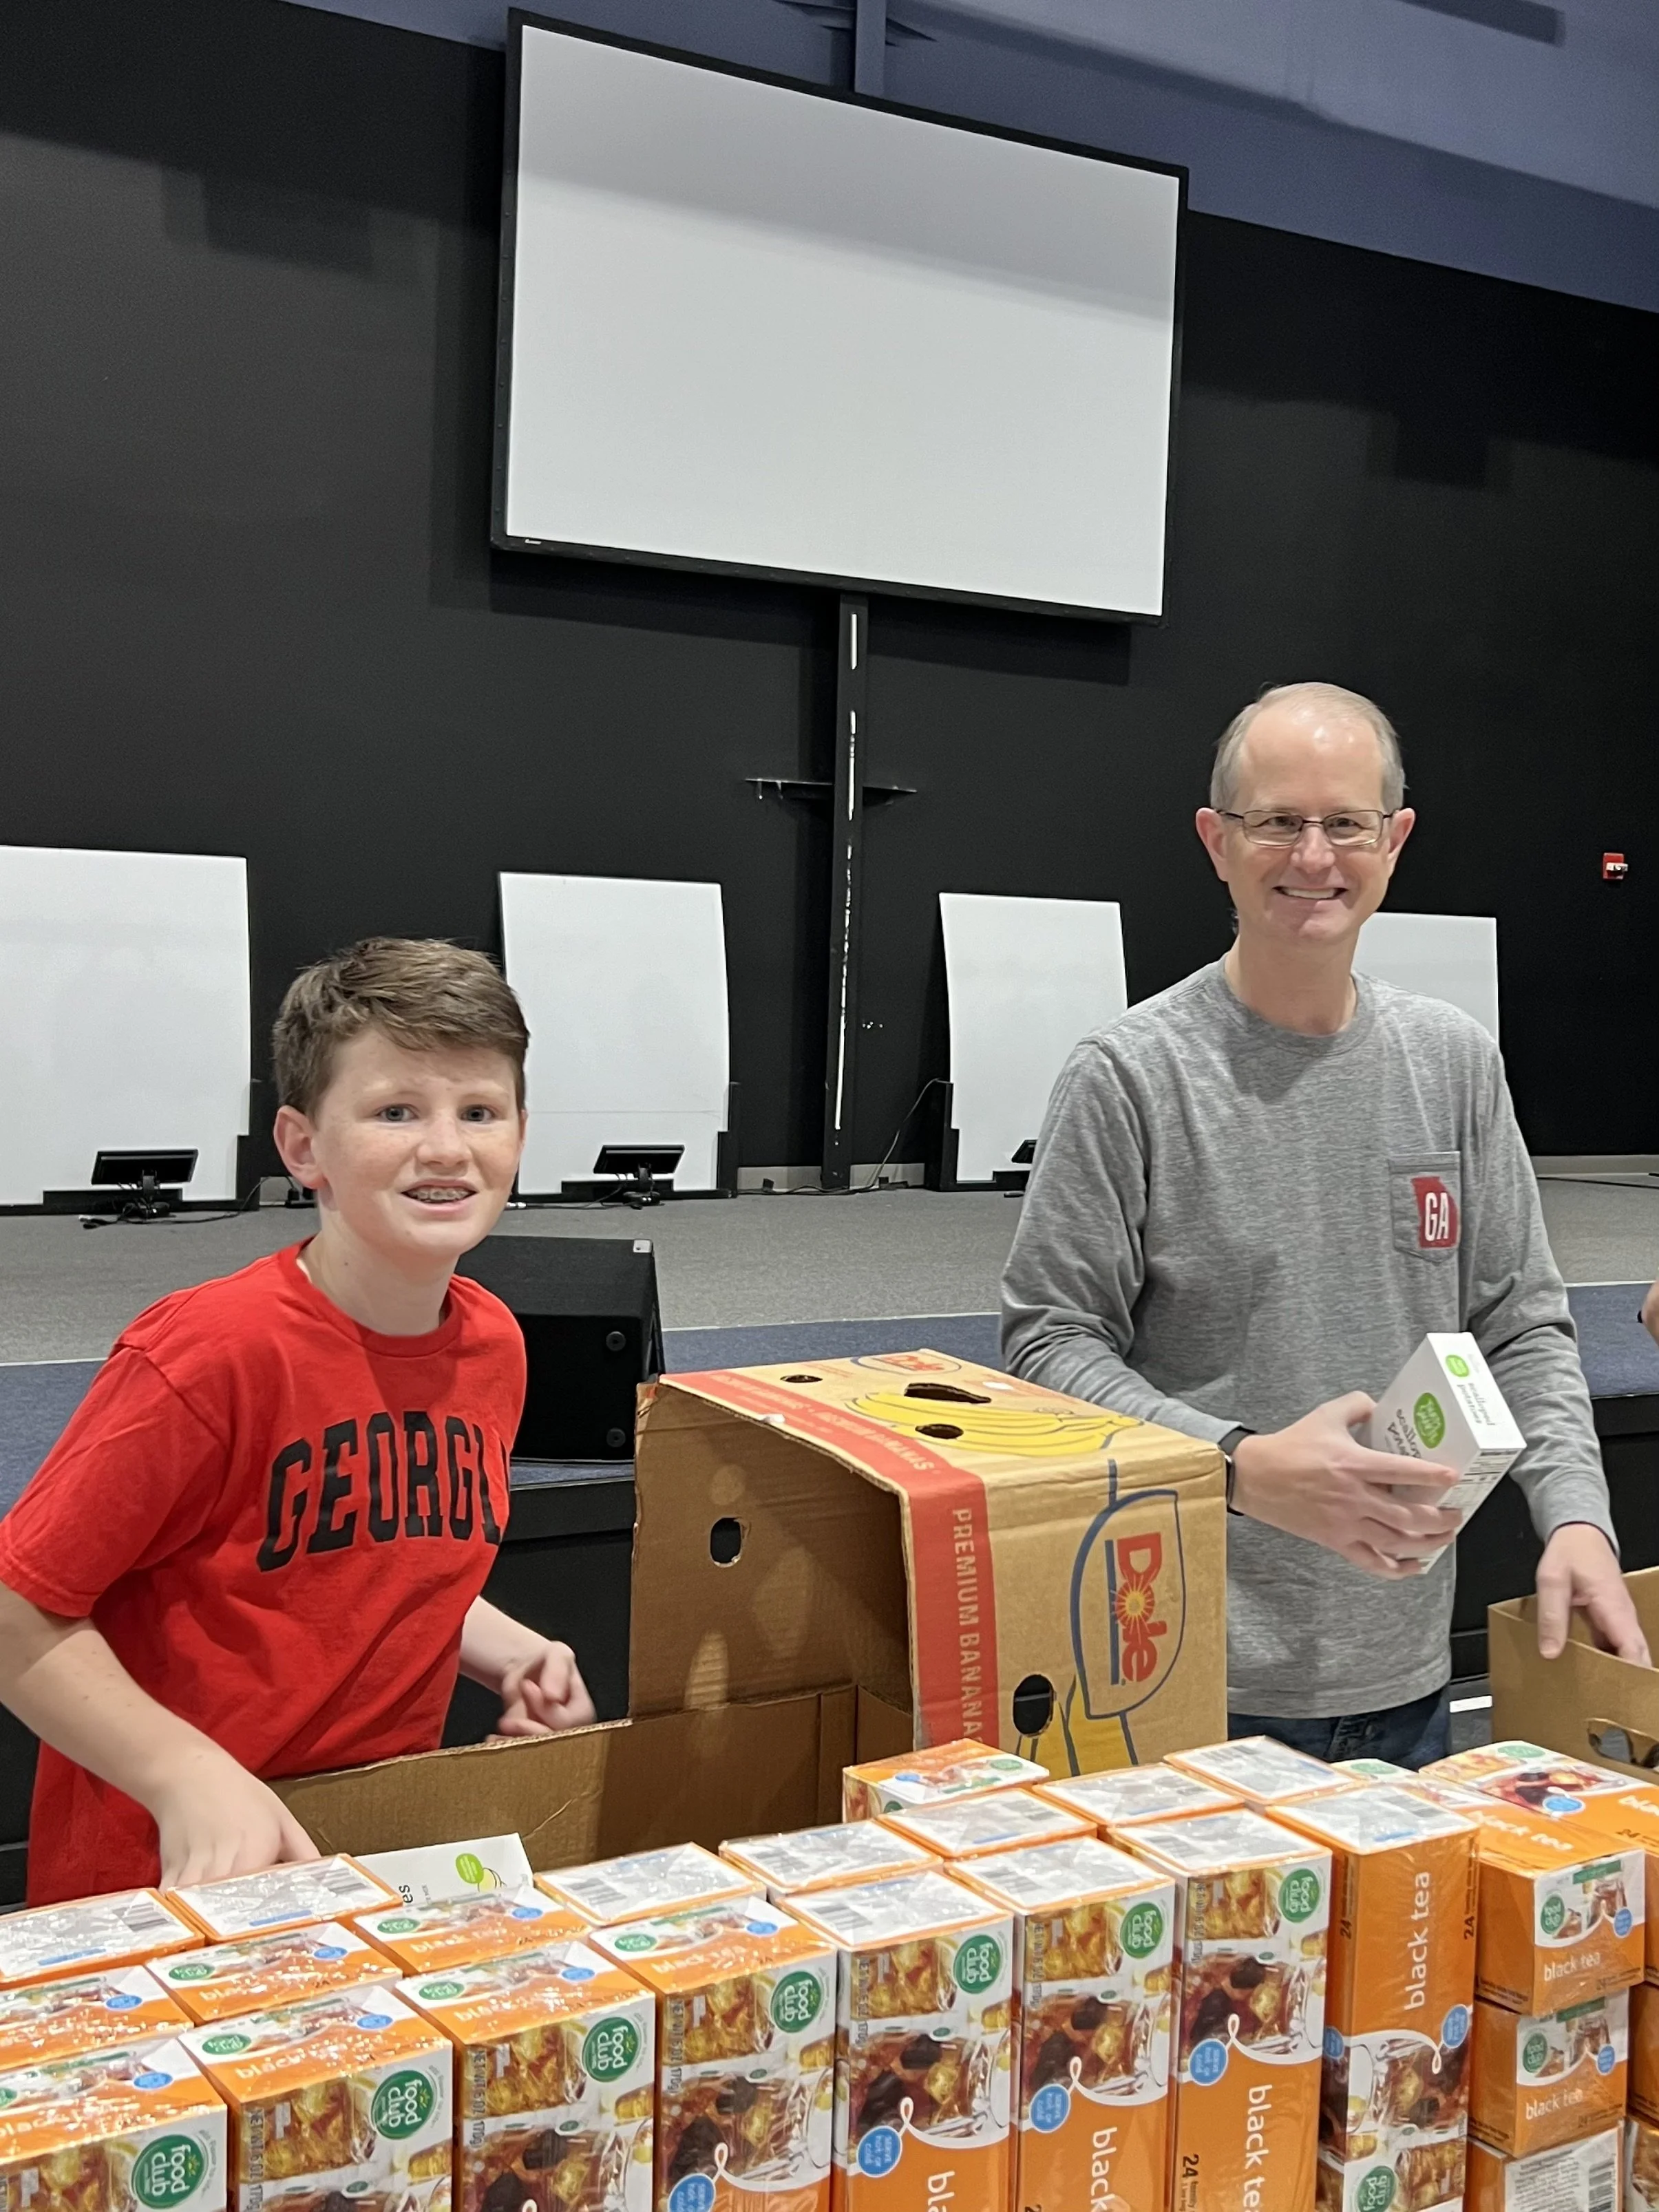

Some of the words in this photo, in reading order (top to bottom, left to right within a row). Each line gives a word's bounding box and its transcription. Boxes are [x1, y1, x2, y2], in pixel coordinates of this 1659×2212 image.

[1425, 1192, 1449, 1242] GA
[953, 1509, 979, 1626] PREMIUM
[1114, 1532, 1167, 1683] Dole
[960, 1633, 984, 1743] BANANA
[1288, 1879, 1302, 1915] club
[1300, 1875, 1315, 1913] food
[1411, 1871, 1430, 1921] tea
[1131, 1914, 1145, 1950] club
[1143, 1908, 1158, 1949] food
[965, 1947, 981, 1985] club
[979, 1942, 995, 1984] food
[1404, 1927, 1428, 2011] black
[1544, 1954, 1576, 1982] black
[1581, 1952, 1601, 1967] tea
[783, 1985, 799, 2023] club
[797, 1978, 813, 2021] food
[596, 2032, 613, 2071] club
[612, 2025, 628, 2069] food
[387, 2087, 405, 2128] club
[405, 2078, 423, 2125] food
[1525, 2094, 1559, 2120] black
[1563, 2088, 1583, 2107] tea
[1245, 2084, 1272, 2169] black
[151, 2151, 171, 2197] club
[170, 2144, 191, 2193] food
[1090, 2127, 1118, 2212] black
[1183, 2153, 1199, 2178] 24
[1243, 2176, 1265, 2212] te
[1363, 2177, 1377, 2211] food
[1375, 2175, 1388, 2205] club
